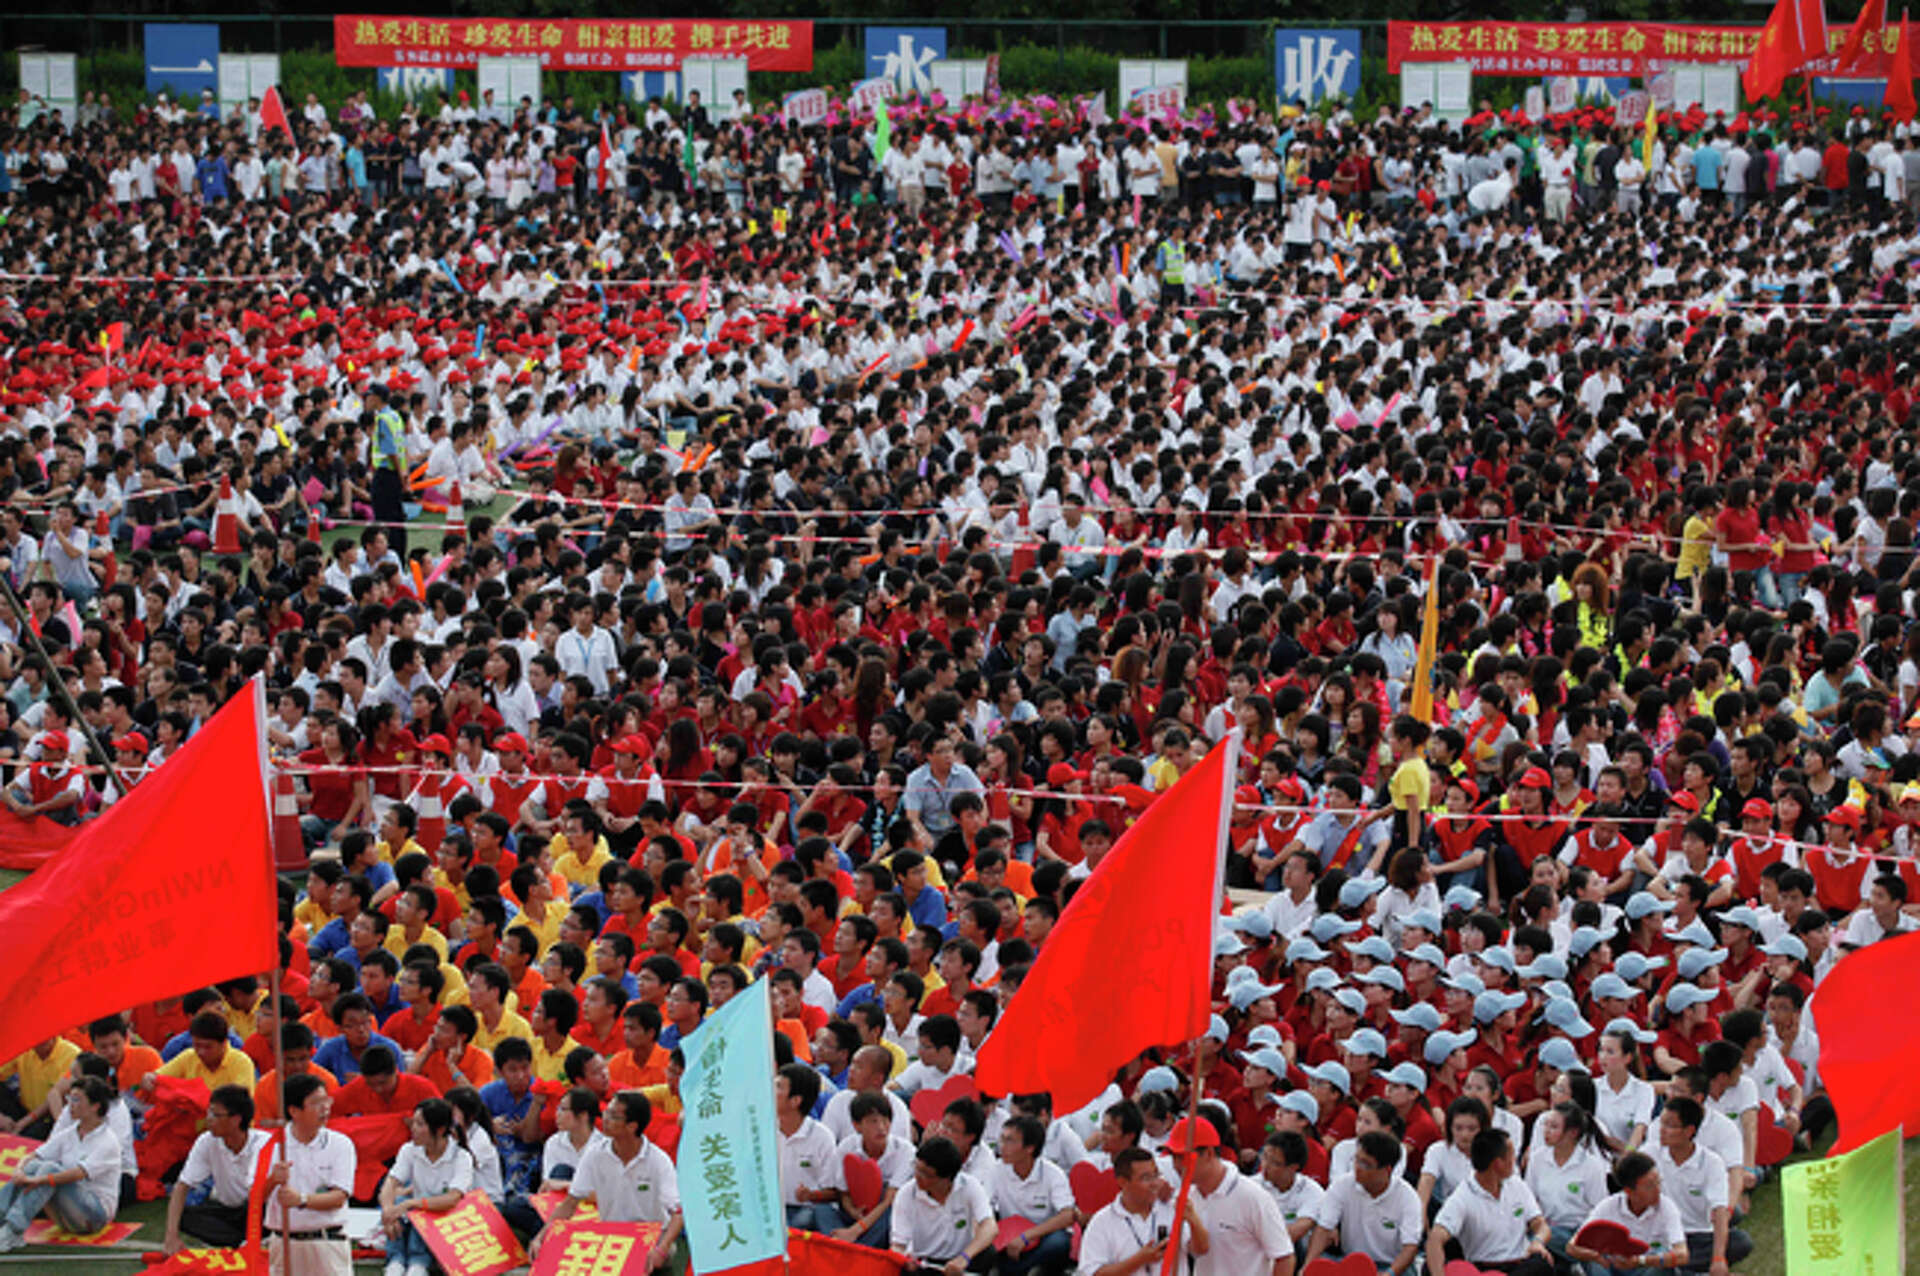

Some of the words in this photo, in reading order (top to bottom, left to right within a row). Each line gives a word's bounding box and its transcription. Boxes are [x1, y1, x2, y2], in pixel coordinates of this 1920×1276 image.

[355, 20, 450, 46] 热爱生活
[464, 22, 563, 48] 珍爱生命
[577, 23, 676, 49] 相亲相爱
[1409, 25, 1519, 52] 热爱生活
[1535, 27, 1646, 53] 珍爱生命
[871, 34, 939, 97] 水
[1283, 35, 1356, 108] 收
